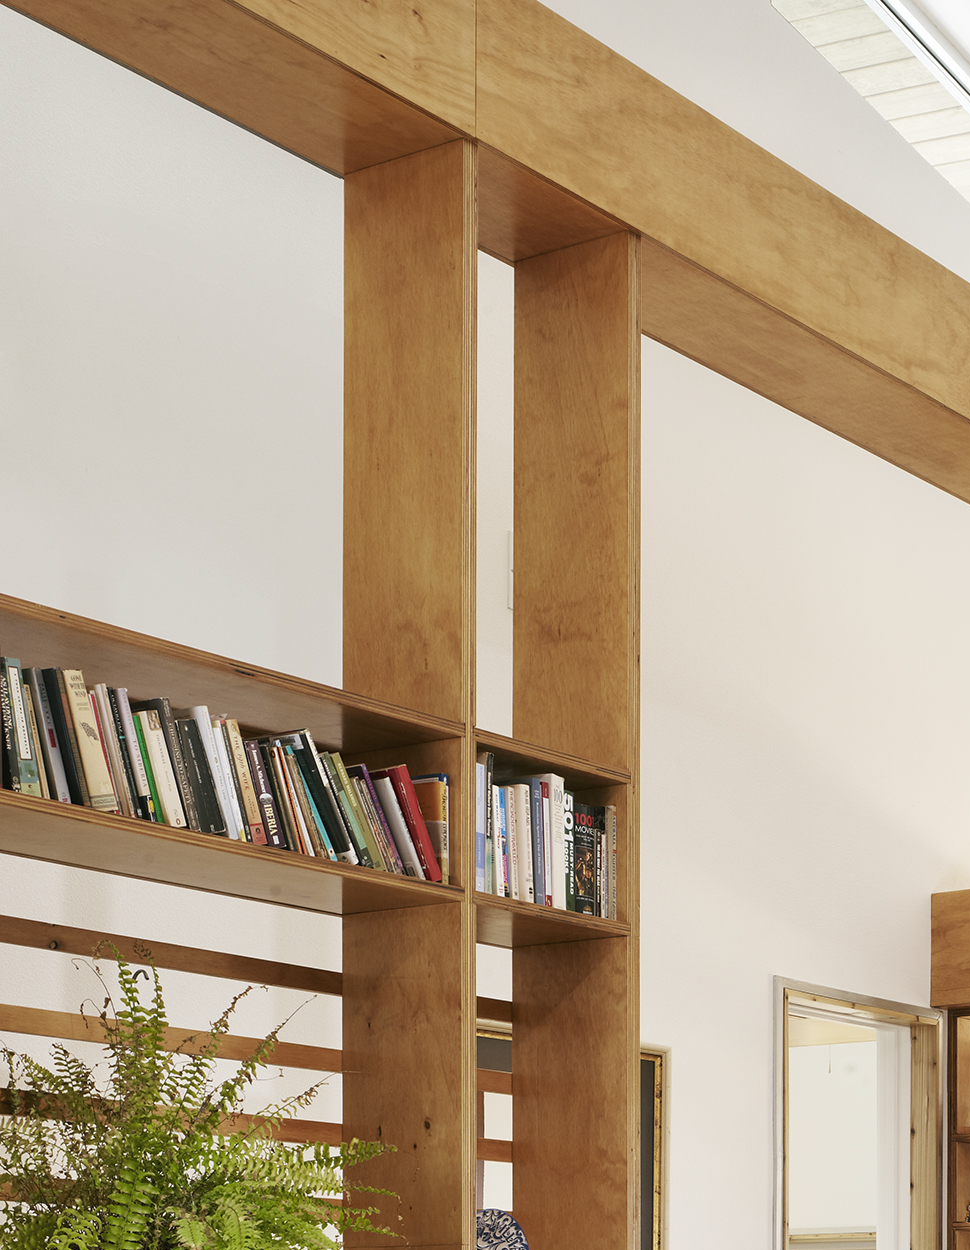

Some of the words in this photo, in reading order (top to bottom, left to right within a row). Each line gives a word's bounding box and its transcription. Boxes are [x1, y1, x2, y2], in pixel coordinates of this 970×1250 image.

[242, 772, 250, 791] WIFE
[264, 804, 278, 835] IBERIA
[564, 792, 574, 842] 501
[574, 812, 595, 828] 1001
